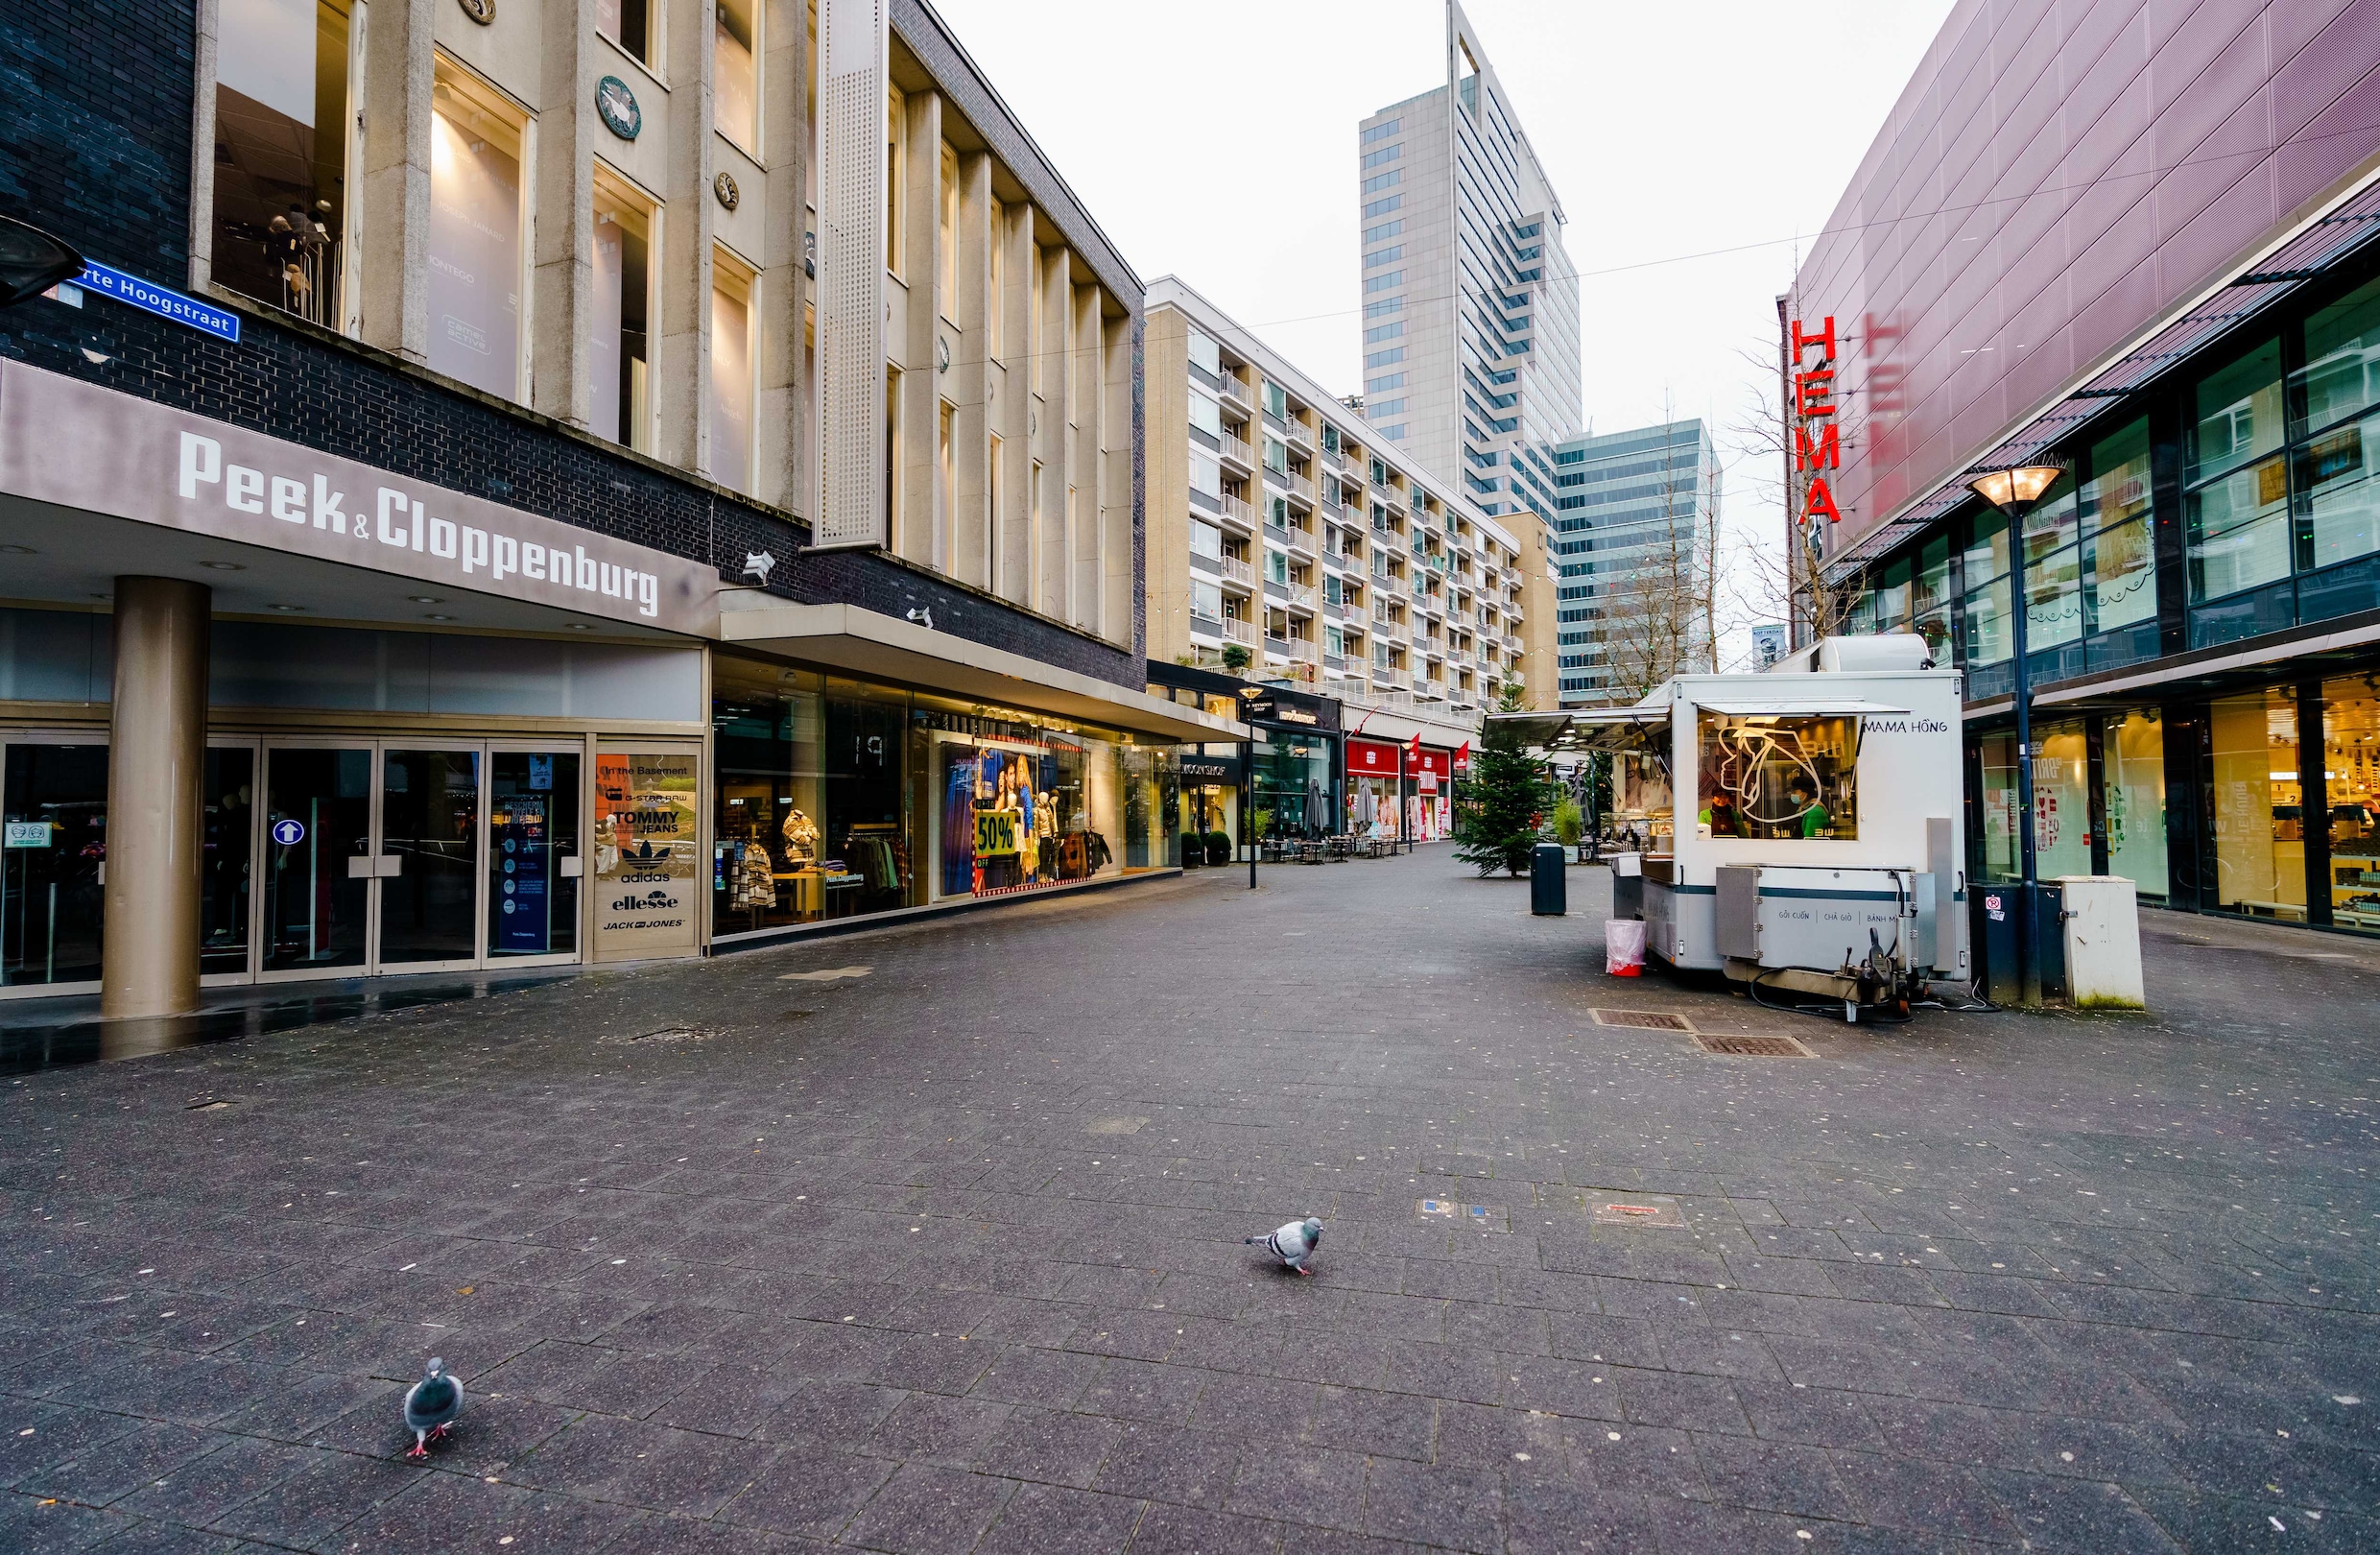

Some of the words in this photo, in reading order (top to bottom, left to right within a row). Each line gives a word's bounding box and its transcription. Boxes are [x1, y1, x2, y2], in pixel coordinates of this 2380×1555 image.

[83, 269, 113, 289] rte
[120, 279, 229, 333] Hoogstraat
[447, 320, 486, 343] camel
[1792, 316, 1842, 525] HEMA
[179, 430, 346, 535] Peek
[353, 513, 370, 540] &
[377, 486, 658, 618] Cloppenburg
[1863, 721, 1907, 733] MAMA
[605, 766, 615, 776] In
[617, 766, 633, 776] the
[637, 766, 688, 776] Basement
[504, 801, 544, 810] BESCHERM
[613, 811, 679, 825] TOMMY
[639, 825, 678, 833] JEANS
[978, 816, 1013, 851] 50%
[977, 858, 989, 868] OFF
[620, 872, 670, 883] adidas
[612, 895, 678, 911] ellesse
[604, 921, 634, 930] JACK
[646, 919, 683, 928] JONES
[1889, 914, 1897, 923] M
